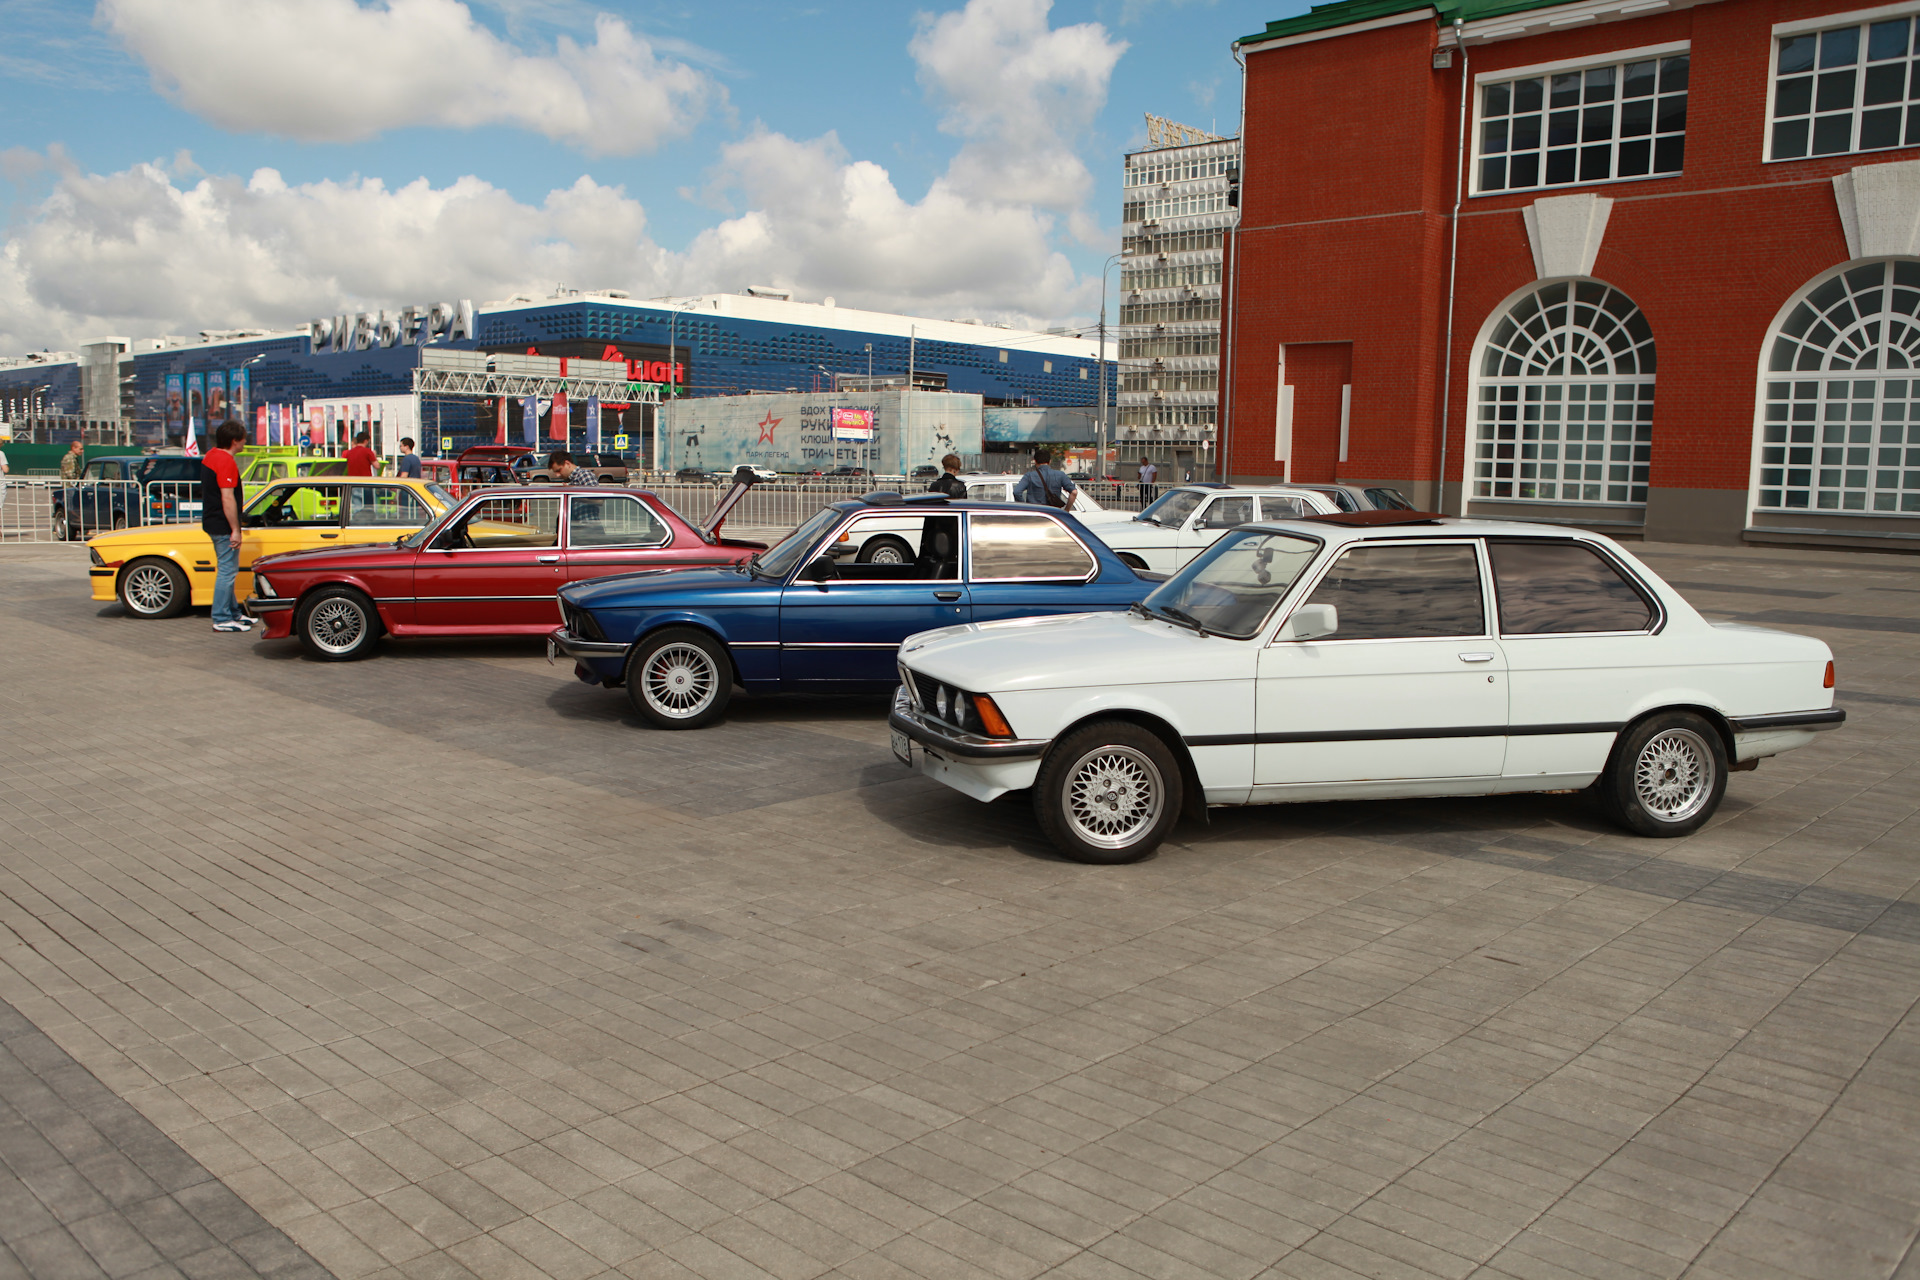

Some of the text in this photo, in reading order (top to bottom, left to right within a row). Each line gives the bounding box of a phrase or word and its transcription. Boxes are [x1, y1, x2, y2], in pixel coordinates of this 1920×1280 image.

[311, 300, 473, 355] РИВЬЕРА
[801, 406, 826, 416] ВДОХ
[764, 451, 789, 459] ЛЕГЕНД
